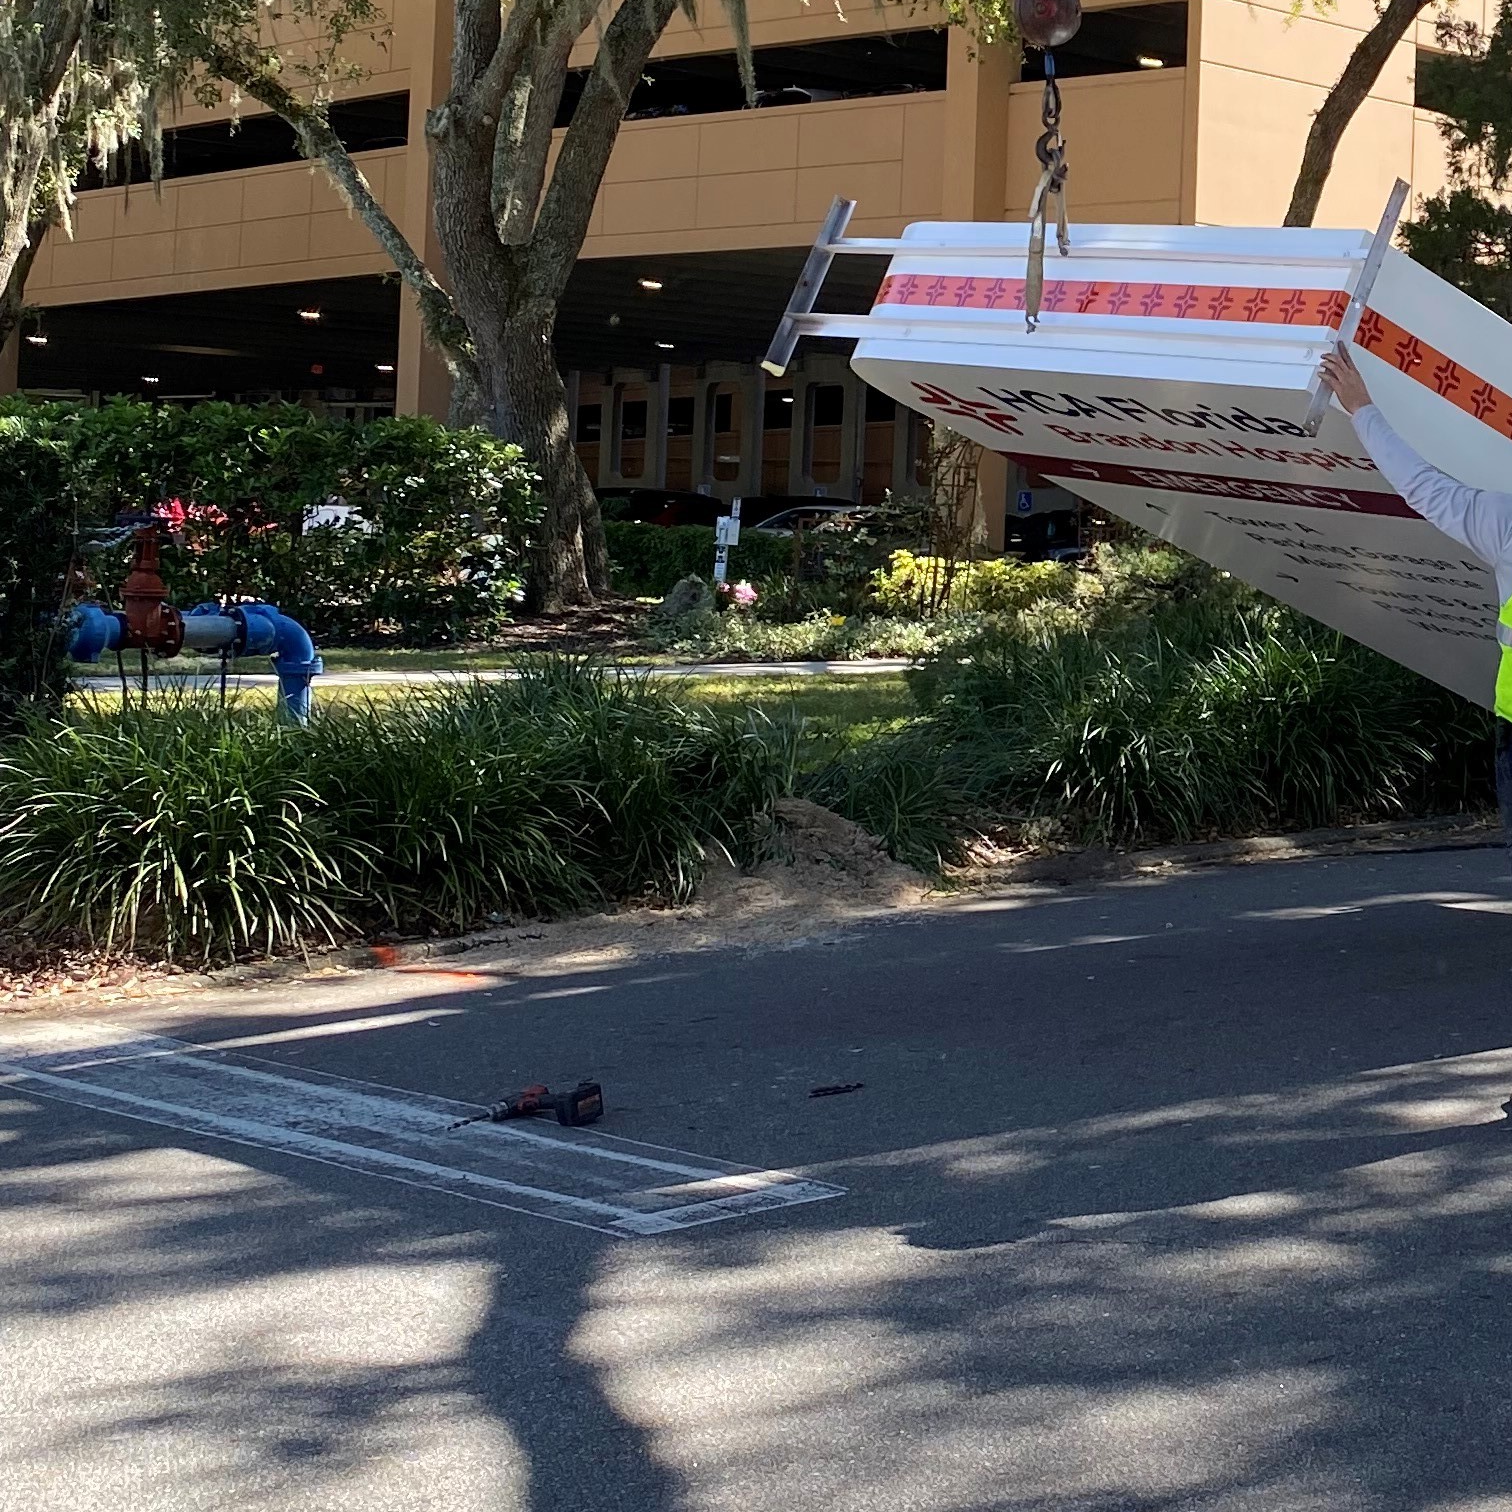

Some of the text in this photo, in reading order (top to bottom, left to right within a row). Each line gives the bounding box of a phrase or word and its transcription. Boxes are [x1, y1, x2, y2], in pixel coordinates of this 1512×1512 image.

[974, 386, 1315, 437] HCA Florida
[1041, 423, 1382, 472] Brandon Hospita
[1127, 470, 1362, 509] EMERGENCY
[1201, 510, 1325, 535] Tower A
[1243, 532, 1490, 574] Parking Garage A
[1283, 553, 1486, 590] Main Entrance
[1335, 581, 1425, 602] Tower
[1424, 594, 1455, 606] B
[1452, 598, 1480, 611] &
[1371, 600, 1480, 627] Parking
